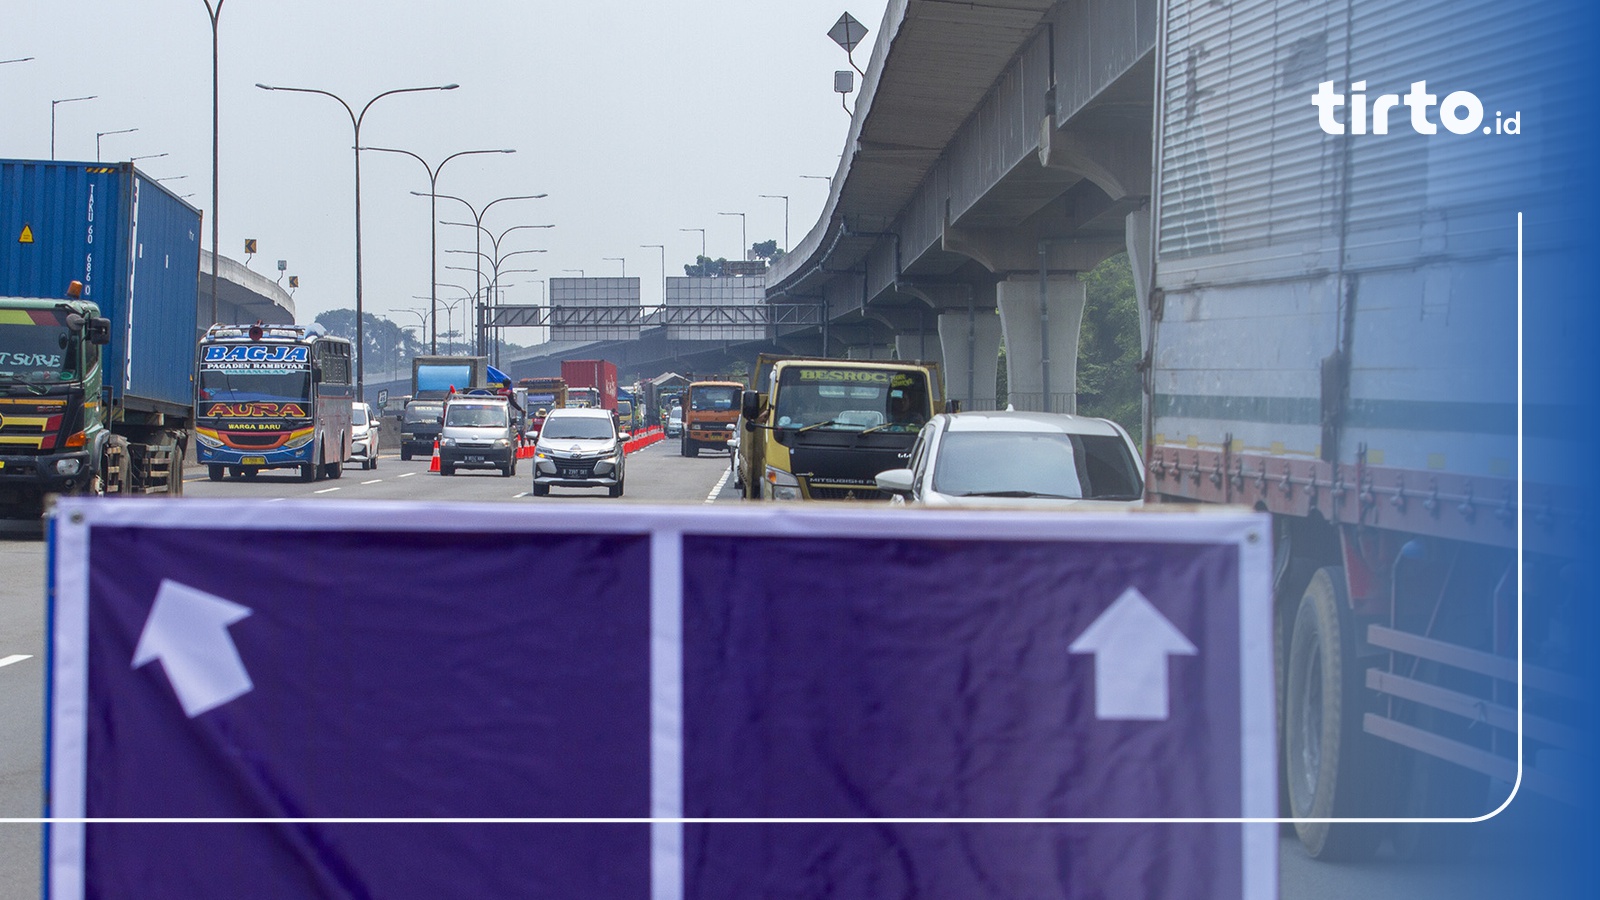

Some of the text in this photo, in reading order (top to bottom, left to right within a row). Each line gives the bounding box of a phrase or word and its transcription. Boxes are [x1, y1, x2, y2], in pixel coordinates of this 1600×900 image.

[205, 346, 307, 361] BAGJA
[207, 403, 306, 417] AURA
[809, 477, 864, 485] MITSUBISHI
